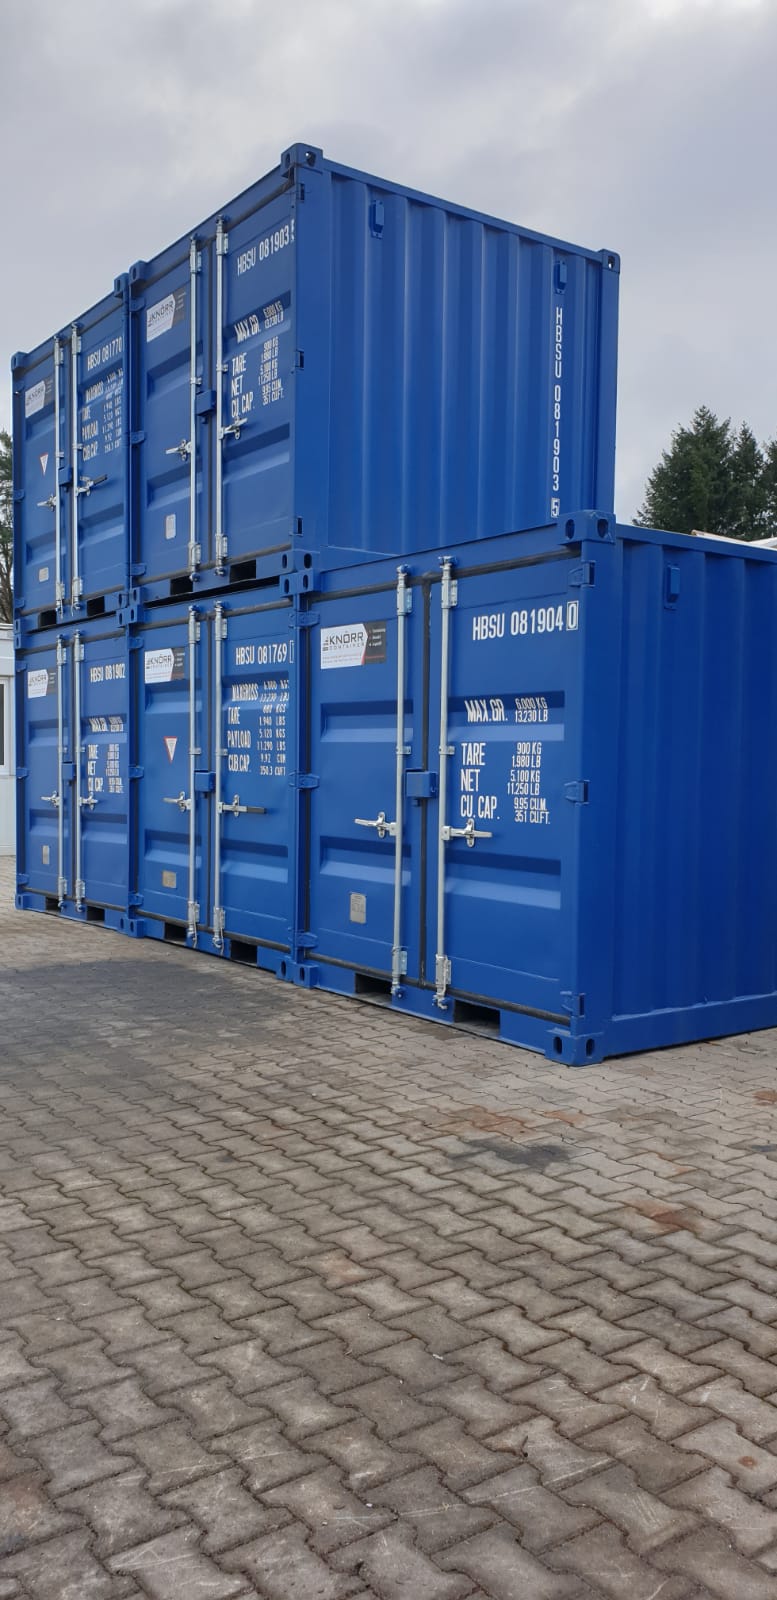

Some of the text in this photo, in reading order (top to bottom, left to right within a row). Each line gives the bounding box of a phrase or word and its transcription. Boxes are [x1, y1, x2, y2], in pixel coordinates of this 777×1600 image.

[237, 246, 256, 276] HBSU
[259, 224, 289, 261] 081903
[87, 336, 122, 371] HBSU 081770
[555, 307, 563, 378] HBSU
[232, 352, 247, 376] TARE
[232, 375, 243, 398] NET
[242, 391, 255, 414] CAP.
[552, 385, 561, 491] 081903
[472, 601, 578, 641] HBSU 081904 0
[329, 631, 364, 645] KNÖRR
[235, 645, 255, 666] HBSU
[257, 643, 288, 665] 081769
[464, 697, 548, 722] MAX.GR. 6.000 KG
[515, 709, 548, 723] 13.230 LB
[227, 730, 251, 749] PAYLOAD
[461, 742, 542, 766] TARE 900 KG
[512, 755, 541, 768] 1.980 LB
[461, 768, 541, 792] NET 5.100 KG
[507, 782, 540, 796] 11.250 LB
[461, 794, 476, 818] CU.
[478, 795, 500, 820] CAP.
[515, 810, 527, 823] 351
